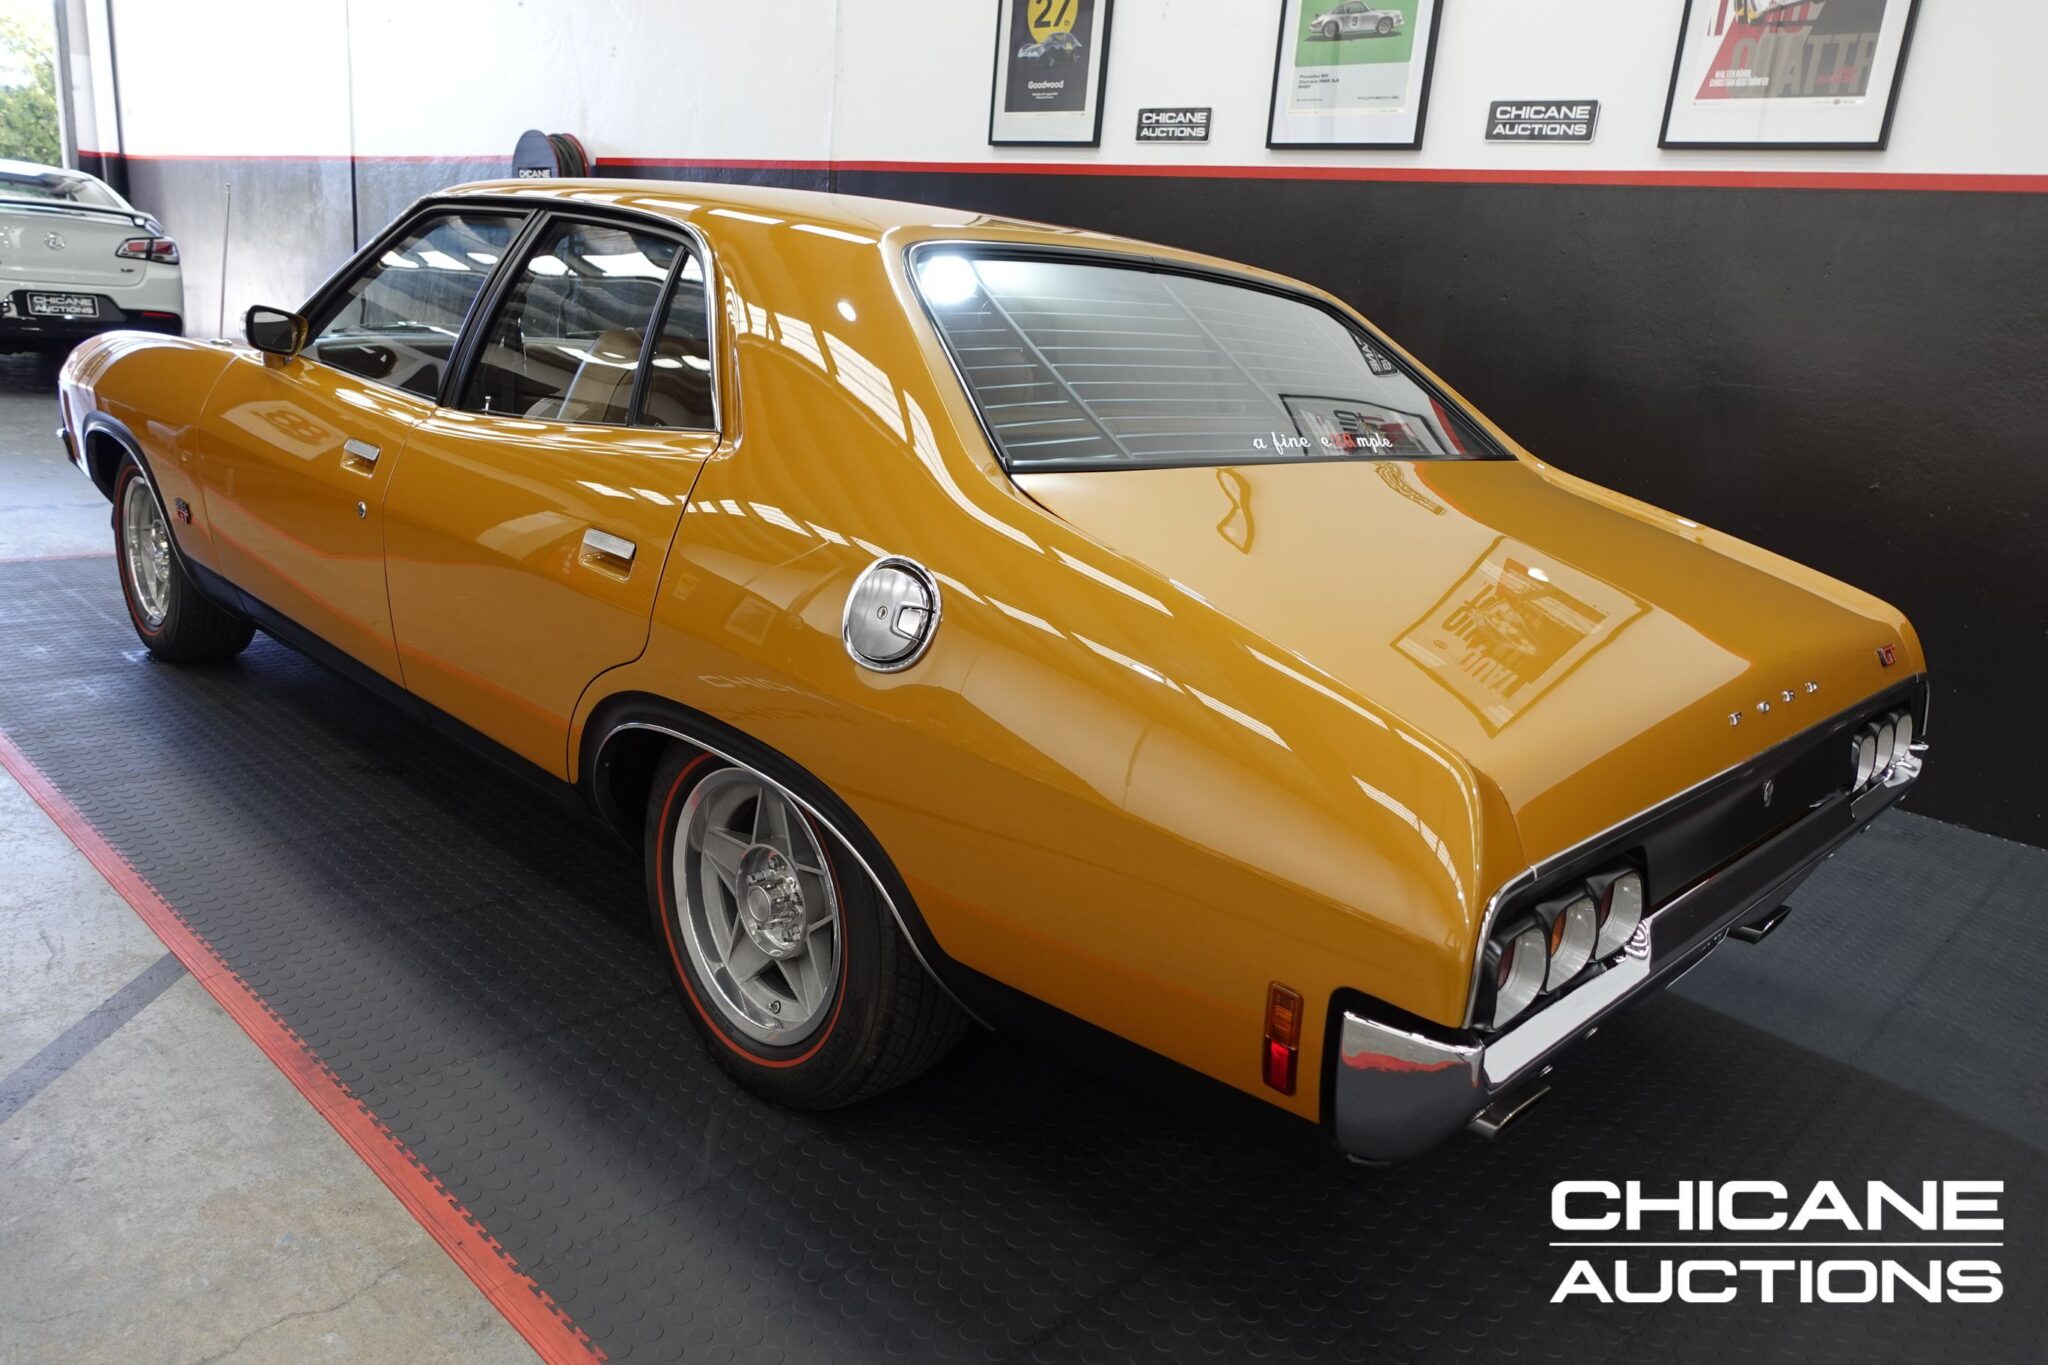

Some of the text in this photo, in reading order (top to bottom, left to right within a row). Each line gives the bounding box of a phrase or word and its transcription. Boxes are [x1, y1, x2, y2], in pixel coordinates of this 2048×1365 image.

[1028, 79, 1064, 89] Goodwood
[1142, 112, 1207, 124] CHICANE
[1496, 106, 1591, 119] CHICANE
[1140, 127, 1206, 137] AUCTIONS
[1493, 124, 1586, 135] AUCTIONS
[33, 295, 93, 306] CHICANE
[34, 304, 94, 314] AUCTIONS
[1253, 437, 1267, 449] a
[1271, 432, 1311, 455] fine
